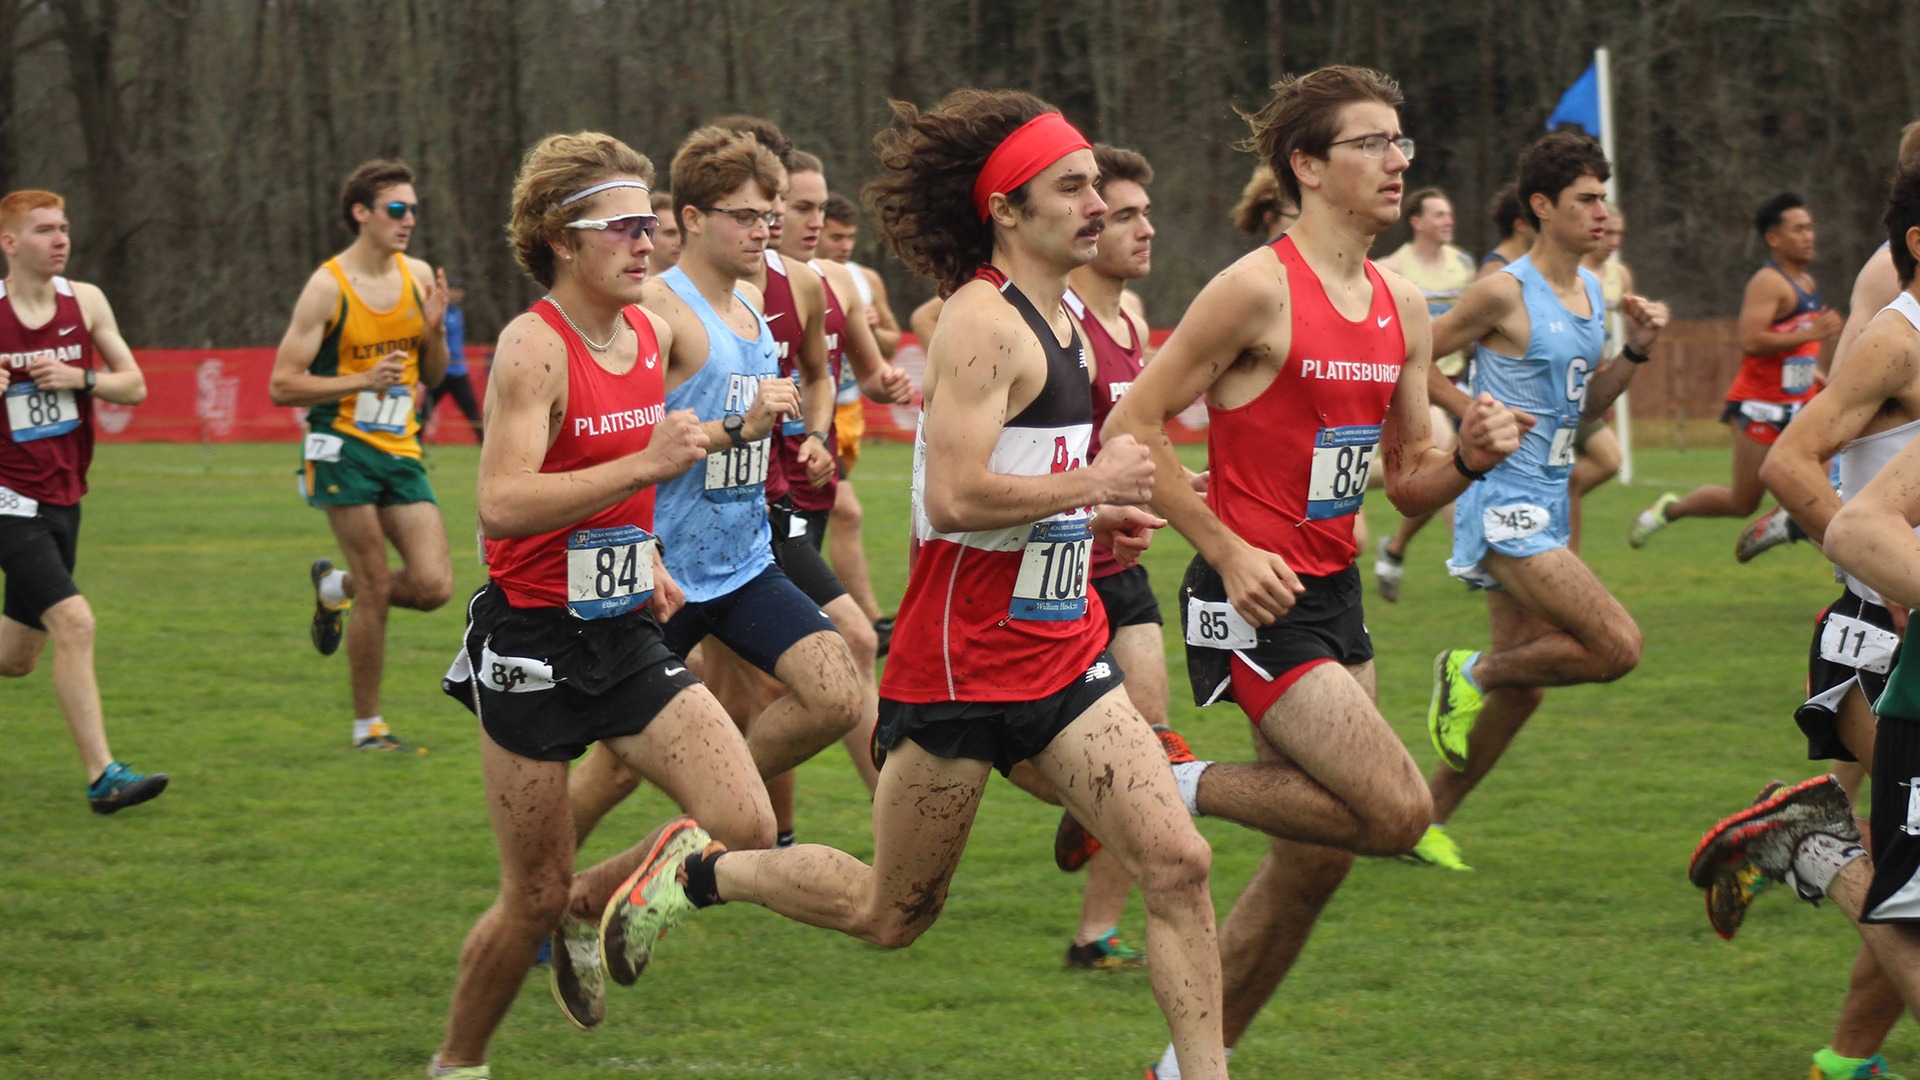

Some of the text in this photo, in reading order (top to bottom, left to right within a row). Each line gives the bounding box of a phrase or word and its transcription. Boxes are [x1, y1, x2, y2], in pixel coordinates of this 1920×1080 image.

[28, 392, 61, 426] 88
[721, 440, 764, 487] 101
[1333, 446, 1374, 499] 85
[1505, 510, 1533, 531] 45
[595, 544, 639, 599] 84
[1039, 541, 1086, 600] 106
[1200, 610, 1229, 640] 85
[1837, 626, 1866, 658] 11
[492, 662, 528, 685] 84
